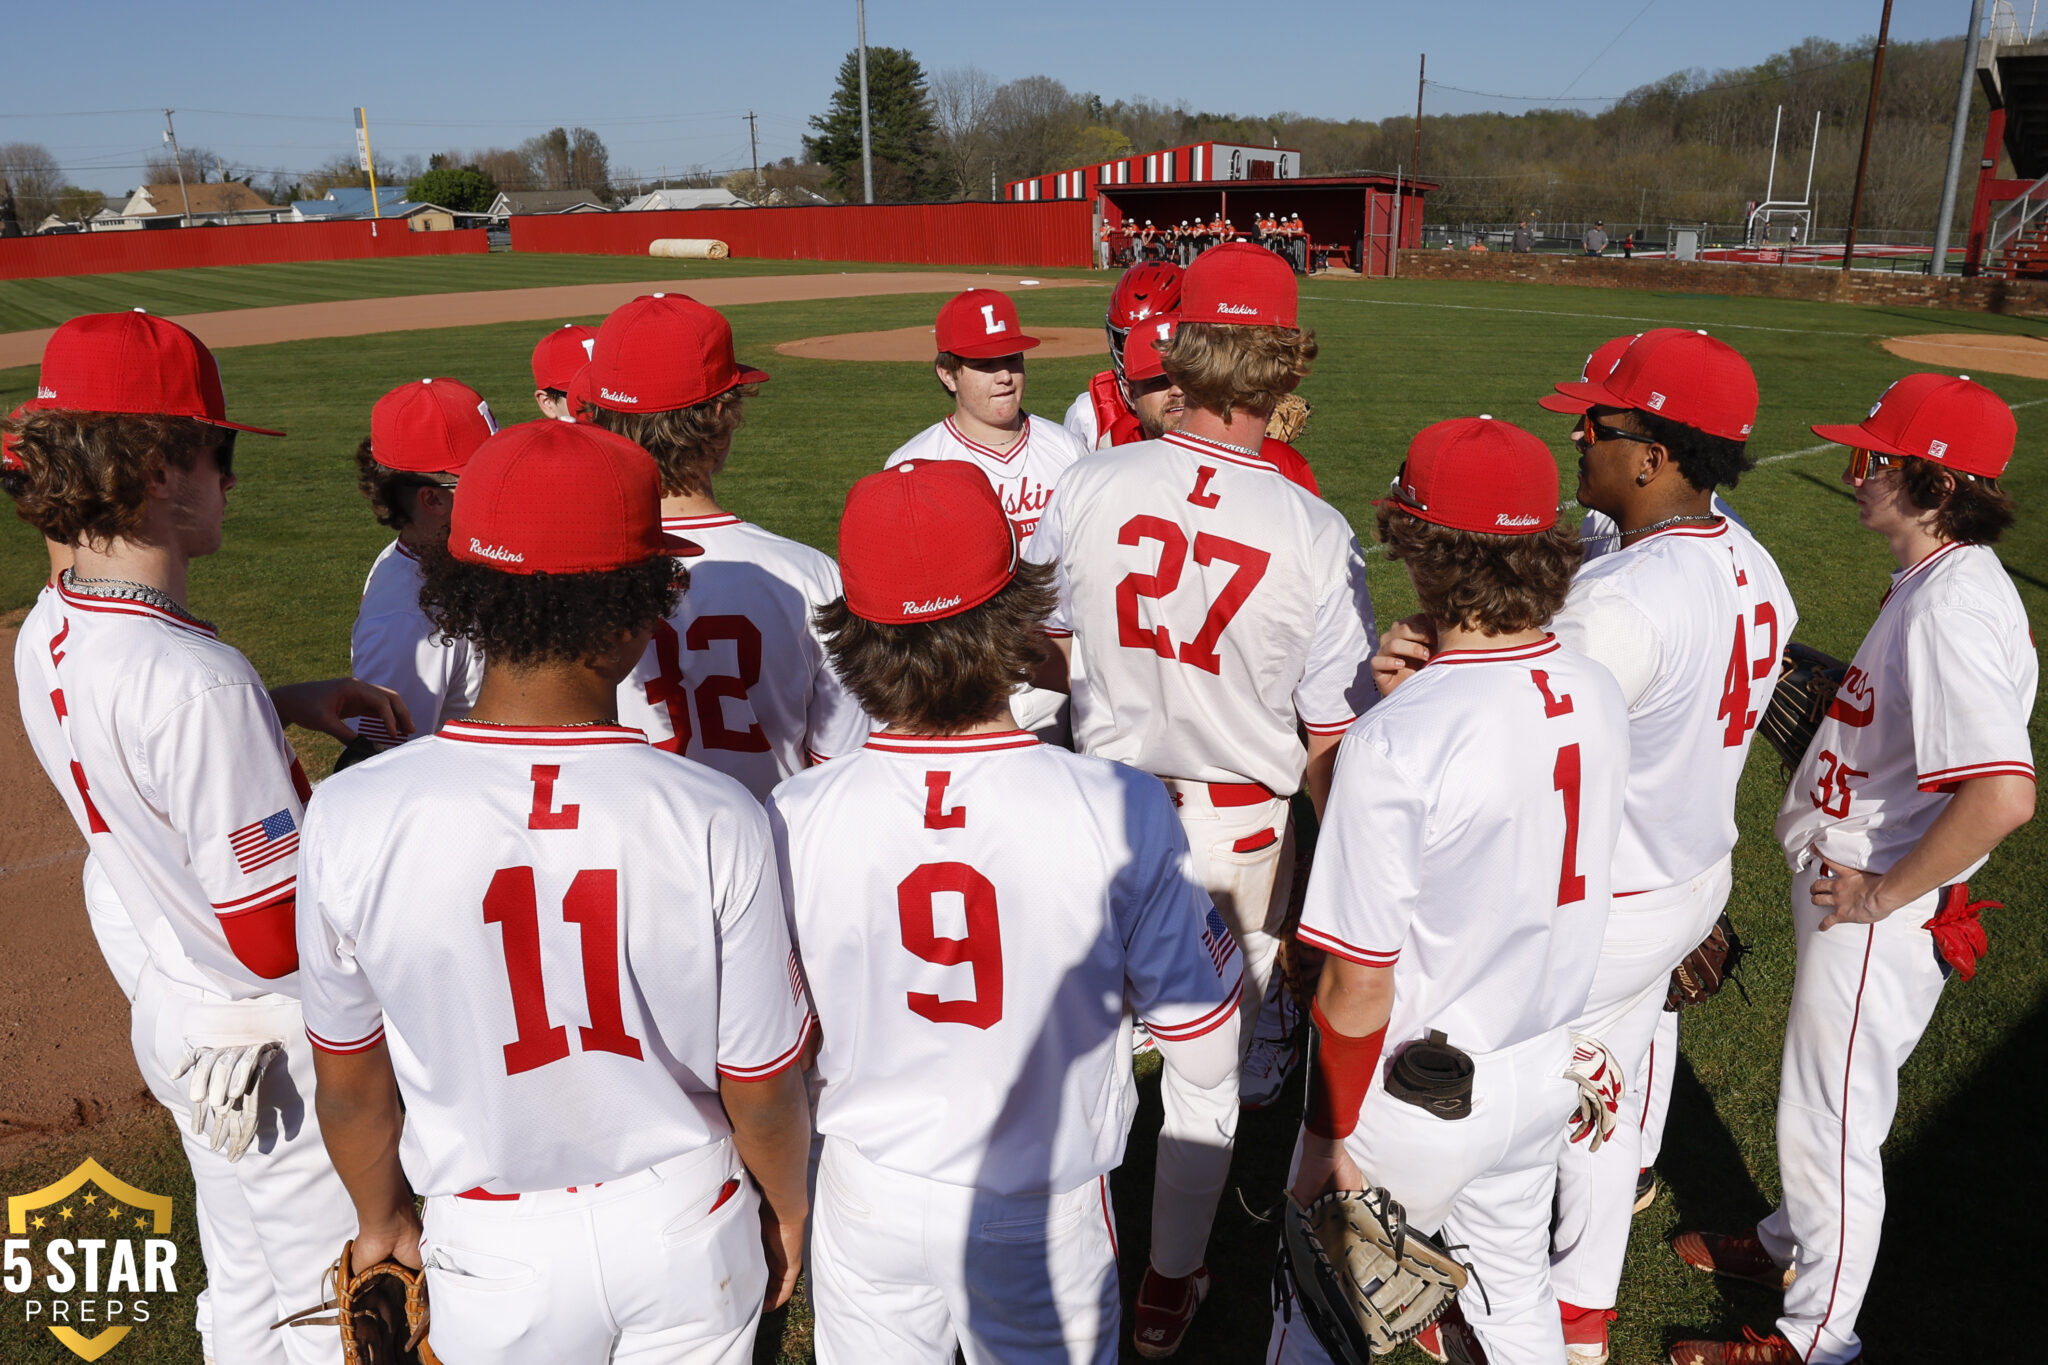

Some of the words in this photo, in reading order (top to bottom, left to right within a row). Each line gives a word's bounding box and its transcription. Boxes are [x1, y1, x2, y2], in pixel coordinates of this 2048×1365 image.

[980, 304, 1007, 335] L
[1216, 302, 1258, 316] Redskins
[600, 387, 639, 405] Redskins
[1187, 465, 1222, 510] L
[1495, 513, 1541, 527] Redskins
[469, 536, 525, 564] Redskins
[902, 593, 962, 615] Redskins
[1115, 514, 1272, 676] 27
[644, 615, 772, 757] 32
[1529, 669, 1575, 719] L
[527, 763, 580, 831] L
[923, 770, 967, 831] L
[1809, 749, 1869, 820] 35
[1553, 743, 1587, 908] 1
[482, 865, 645, 1077] 11
[896, 860, 1004, 1031] 9
